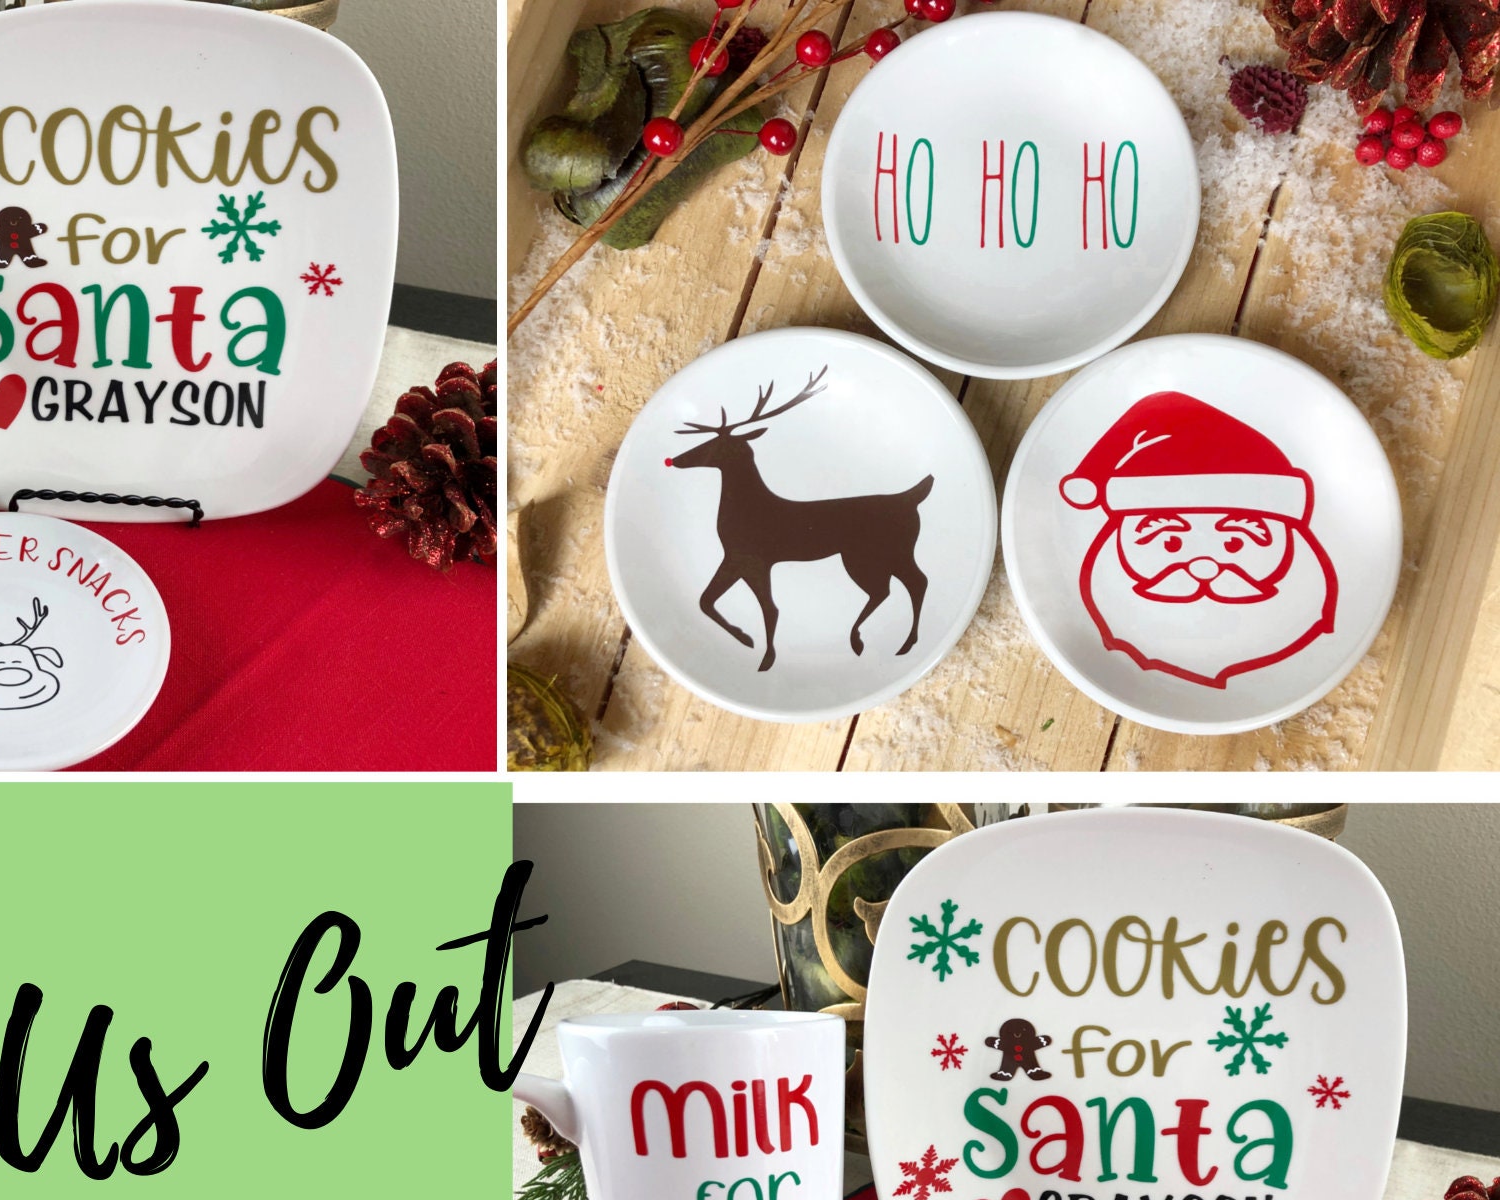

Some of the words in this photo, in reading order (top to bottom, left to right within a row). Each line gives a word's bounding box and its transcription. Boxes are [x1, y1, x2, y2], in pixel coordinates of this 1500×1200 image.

[874, 132, 934, 245] HO
[980, 140, 1039, 248] HO
[1083, 140, 1138, 250] HO
[57, 213, 186, 266] for
[31, 376, 266, 429] GRAYSON
[48, 547, 145, 645] SNACKS
[1061, 1025, 1192, 1079] for
[962, 1087, 1294, 1190] Santa
